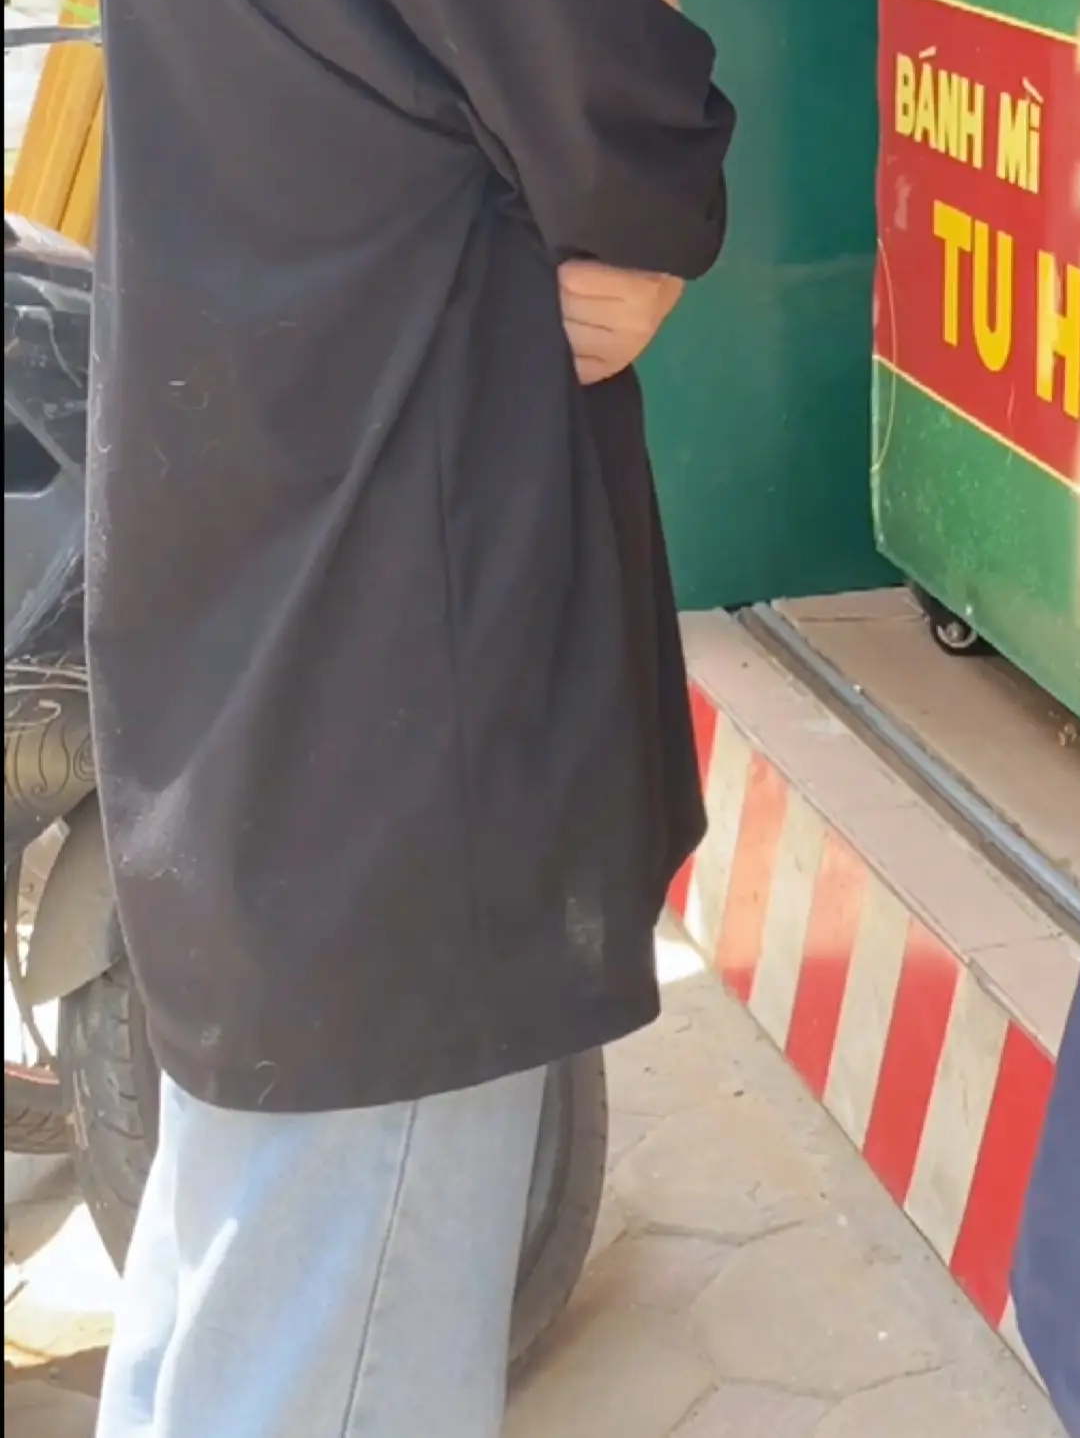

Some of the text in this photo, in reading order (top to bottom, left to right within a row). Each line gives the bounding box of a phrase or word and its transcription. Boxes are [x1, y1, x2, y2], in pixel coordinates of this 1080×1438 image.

[895, 45, 1044, 194] BÁNH MÌ
[933, 199, 1014, 373] TU
